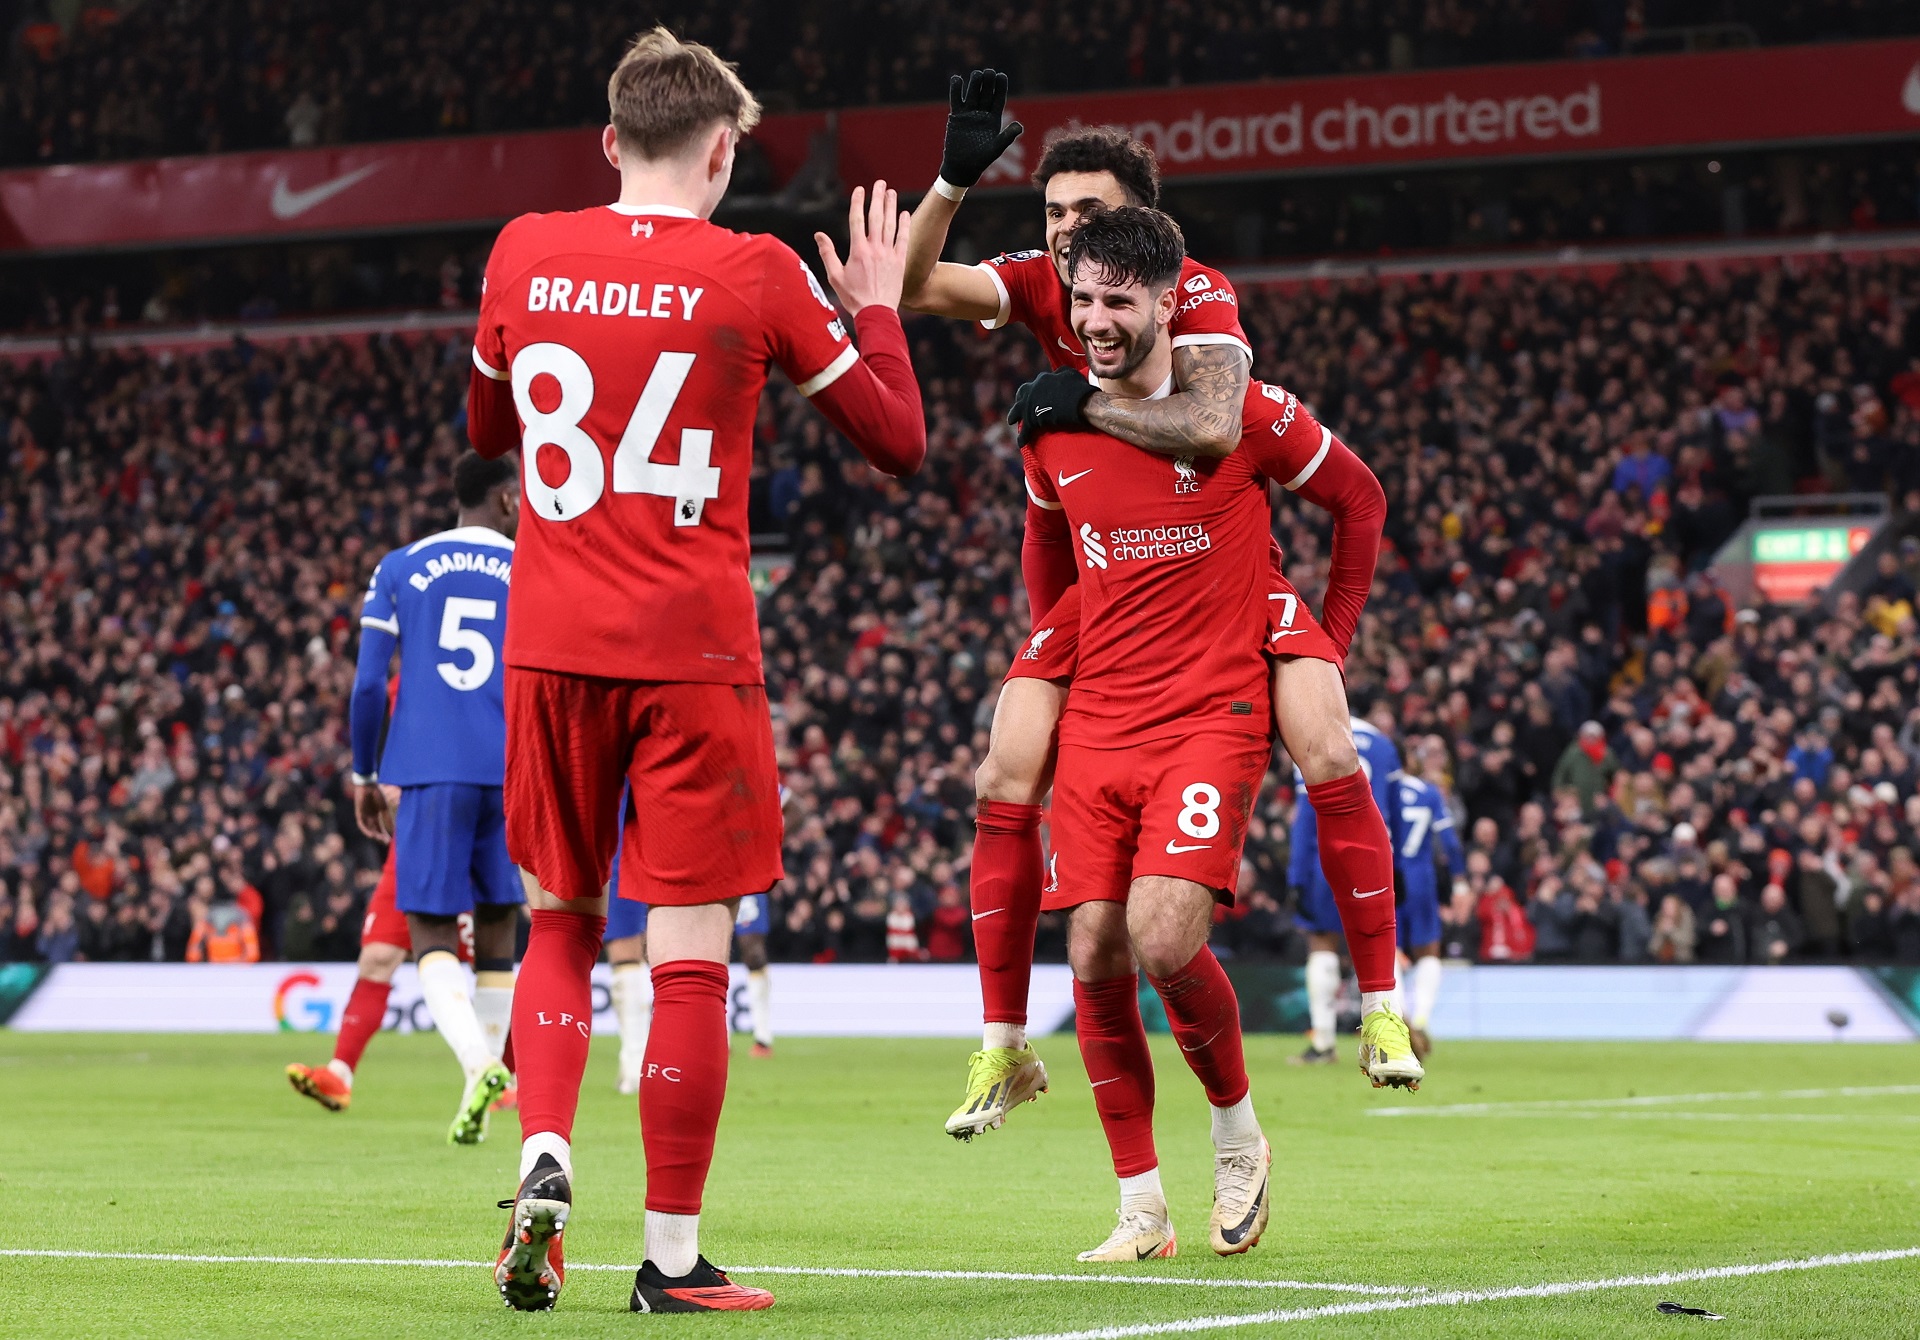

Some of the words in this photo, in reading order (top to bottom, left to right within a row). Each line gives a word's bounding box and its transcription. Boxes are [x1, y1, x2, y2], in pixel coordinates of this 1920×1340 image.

[1044, 104, 1302, 163] ndard
[1310, 83, 1600, 151] chartered
[528, 276, 704, 321] BRADLEY
[511, 341, 721, 527] 84
[1110, 523, 1203, 544] standard
[1113, 533, 1211, 561] chartered
[1268, 593, 1298, 627] 7
[437, 596, 497, 691] 5
[1177, 782, 1221, 839] 8
[1401, 806, 1432, 858] 7
